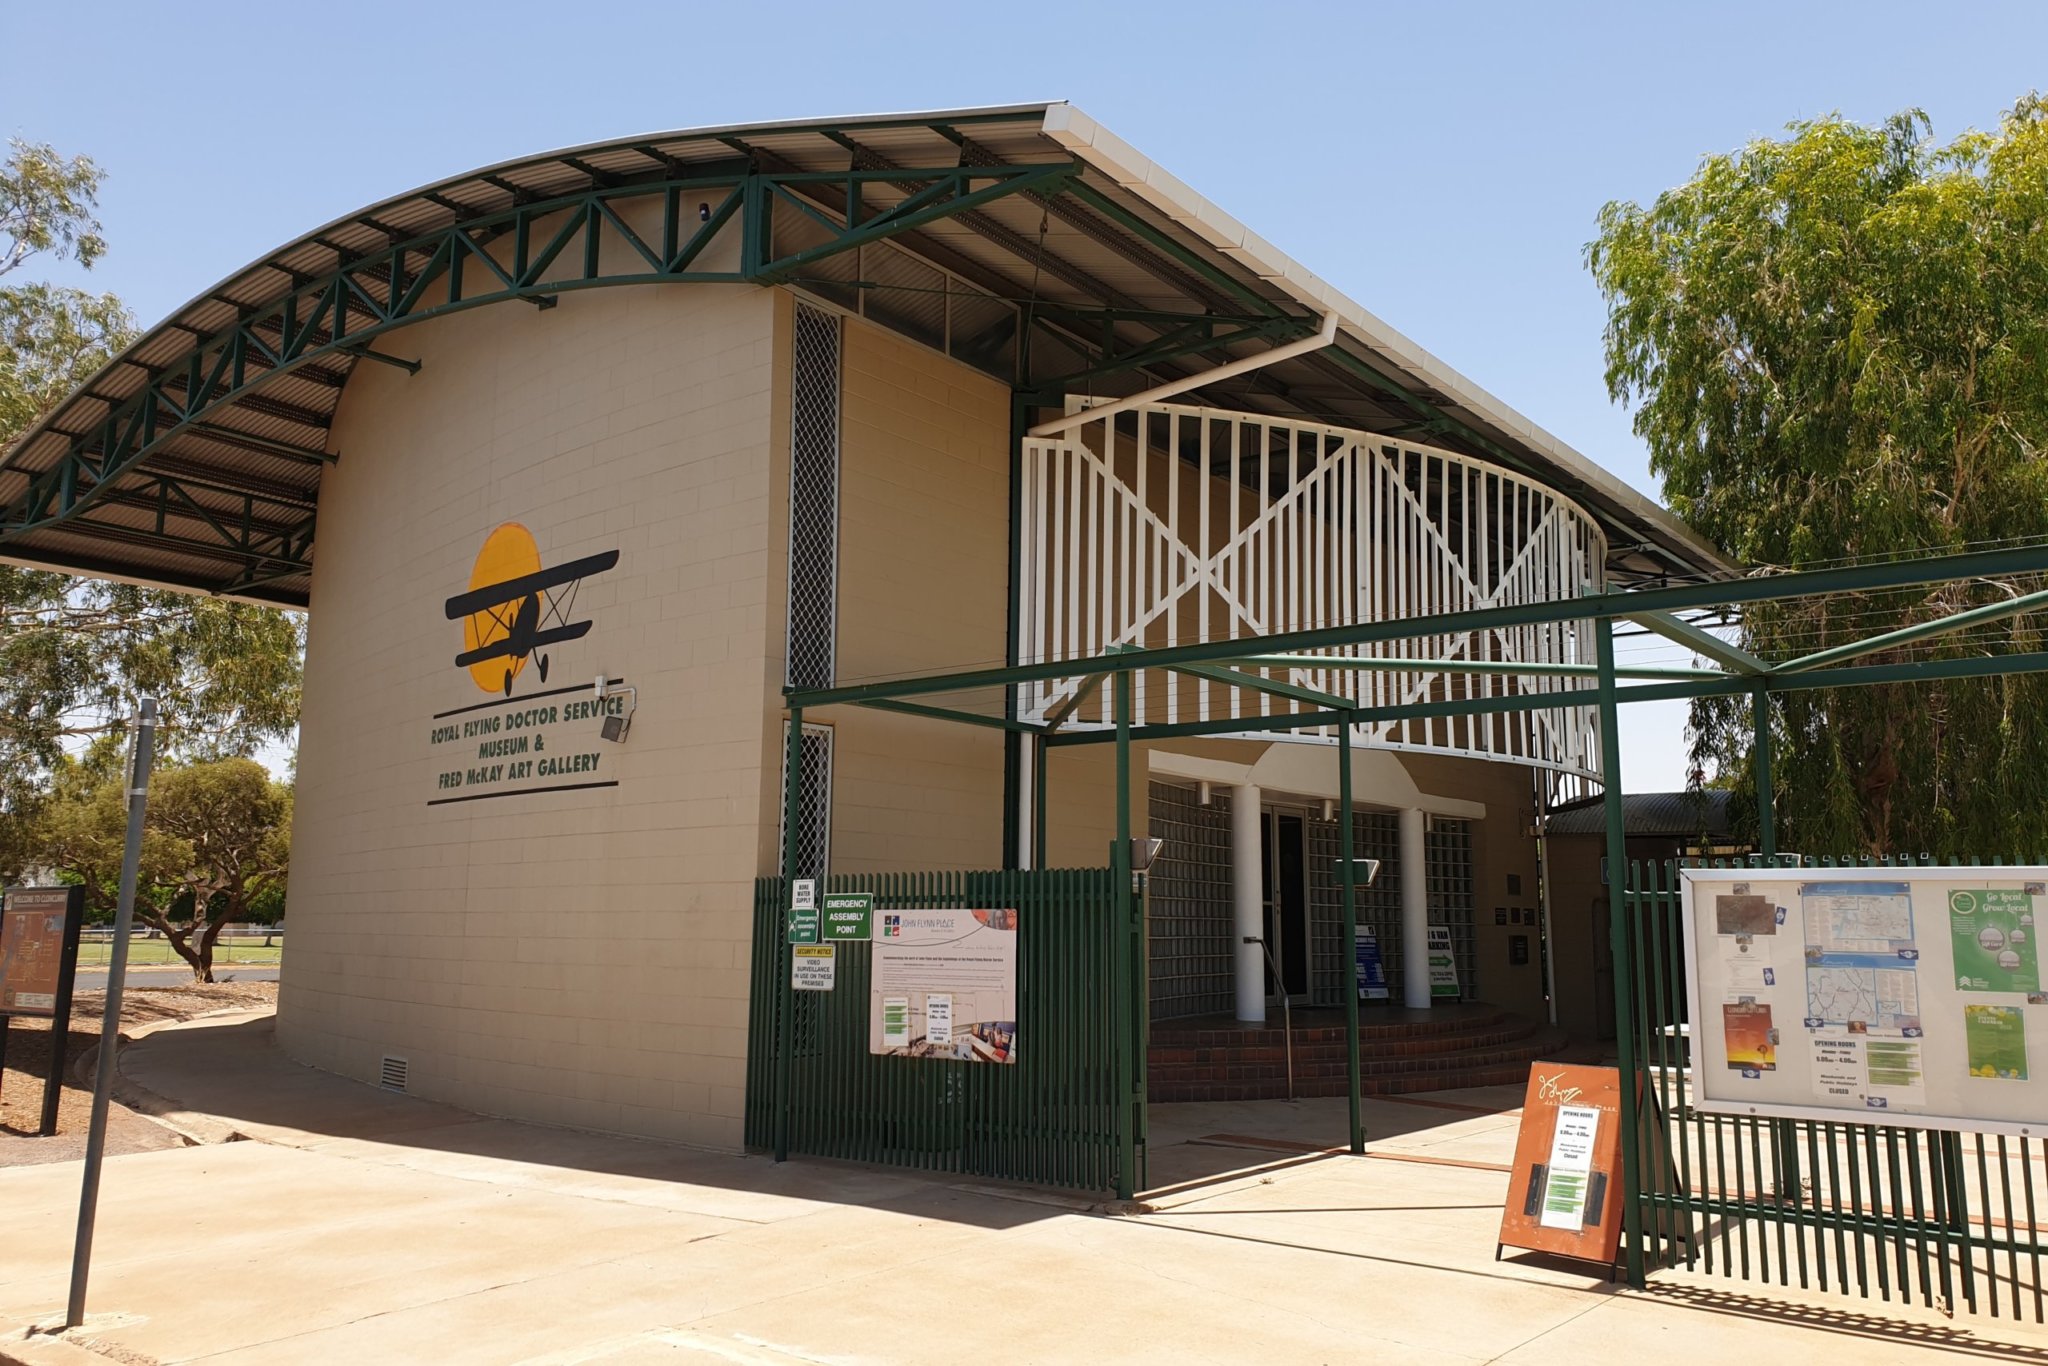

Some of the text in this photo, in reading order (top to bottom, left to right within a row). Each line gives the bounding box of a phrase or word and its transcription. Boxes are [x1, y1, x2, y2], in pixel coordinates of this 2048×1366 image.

[431, 696, 623, 744] ROYAL FLYING DOCTOR SERVICE
[478, 734, 544, 759] MUSEUM &
[439, 752, 600, 789] FRED McKAY ART GALLERY
[1986, 892, 1998, 902] Go
[826, 899, 868, 908] EMERGENCY
[1982, 903, 2005, 913] Grow
[796, 914, 818, 922] Emergency
[829, 912, 864, 921] ASSEMBLY
[901, 918, 955, 928] JOHN FLYNN PLACE
[836, 925, 856, 934] POINT
[1428, 941, 1450, 950] ARKING
